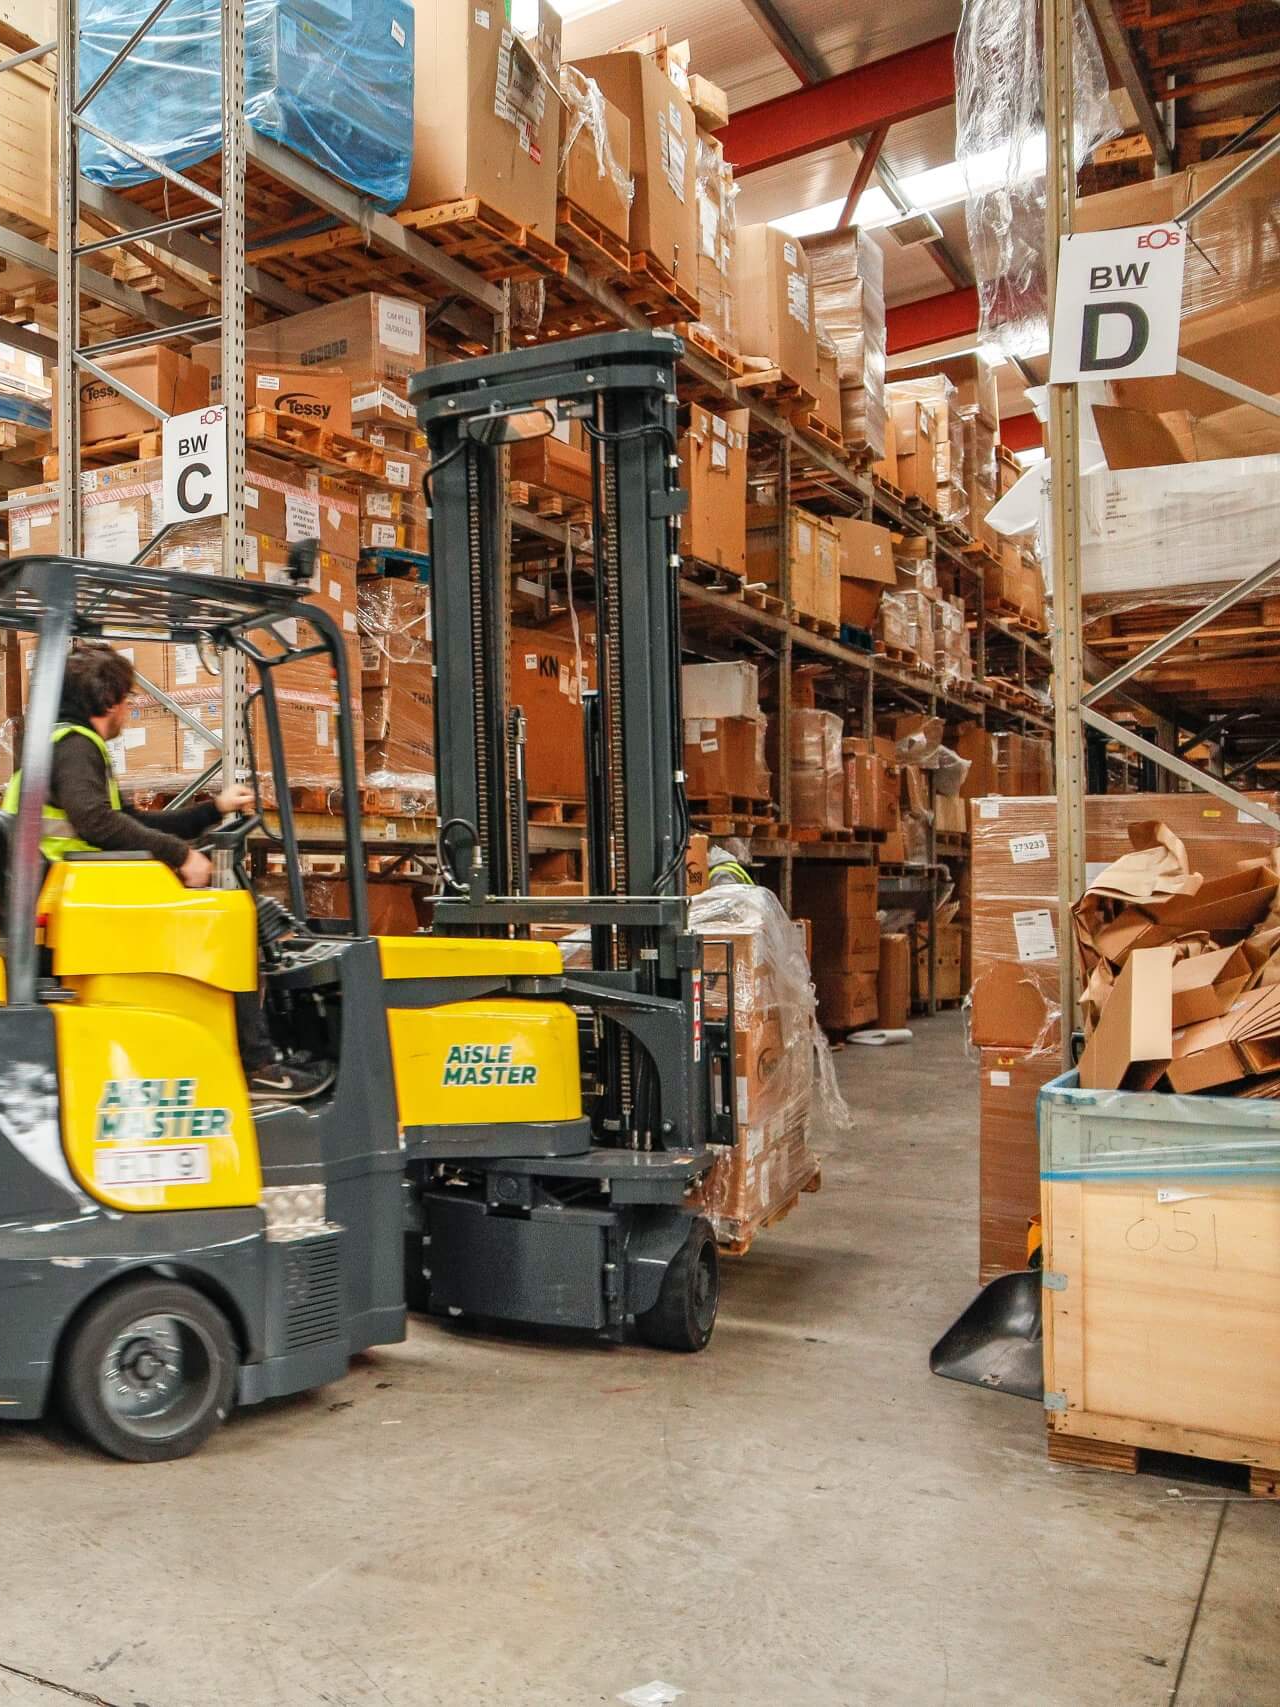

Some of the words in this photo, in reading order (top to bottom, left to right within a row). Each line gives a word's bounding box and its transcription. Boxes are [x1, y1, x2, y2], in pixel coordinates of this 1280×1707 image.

[1137, 229, 1180, 249] EOS
[1089, 261, 1150, 290] BW
[1080, 301, 1150, 372] D
[200, 410, 223, 424] EOS
[287, 399, 331, 420] Tessy
[178, 433, 208, 456] BW
[177, 462, 213, 514] C
[539, 656, 558, 677] KN
[443, 1066, 537, 1085] MASTER
